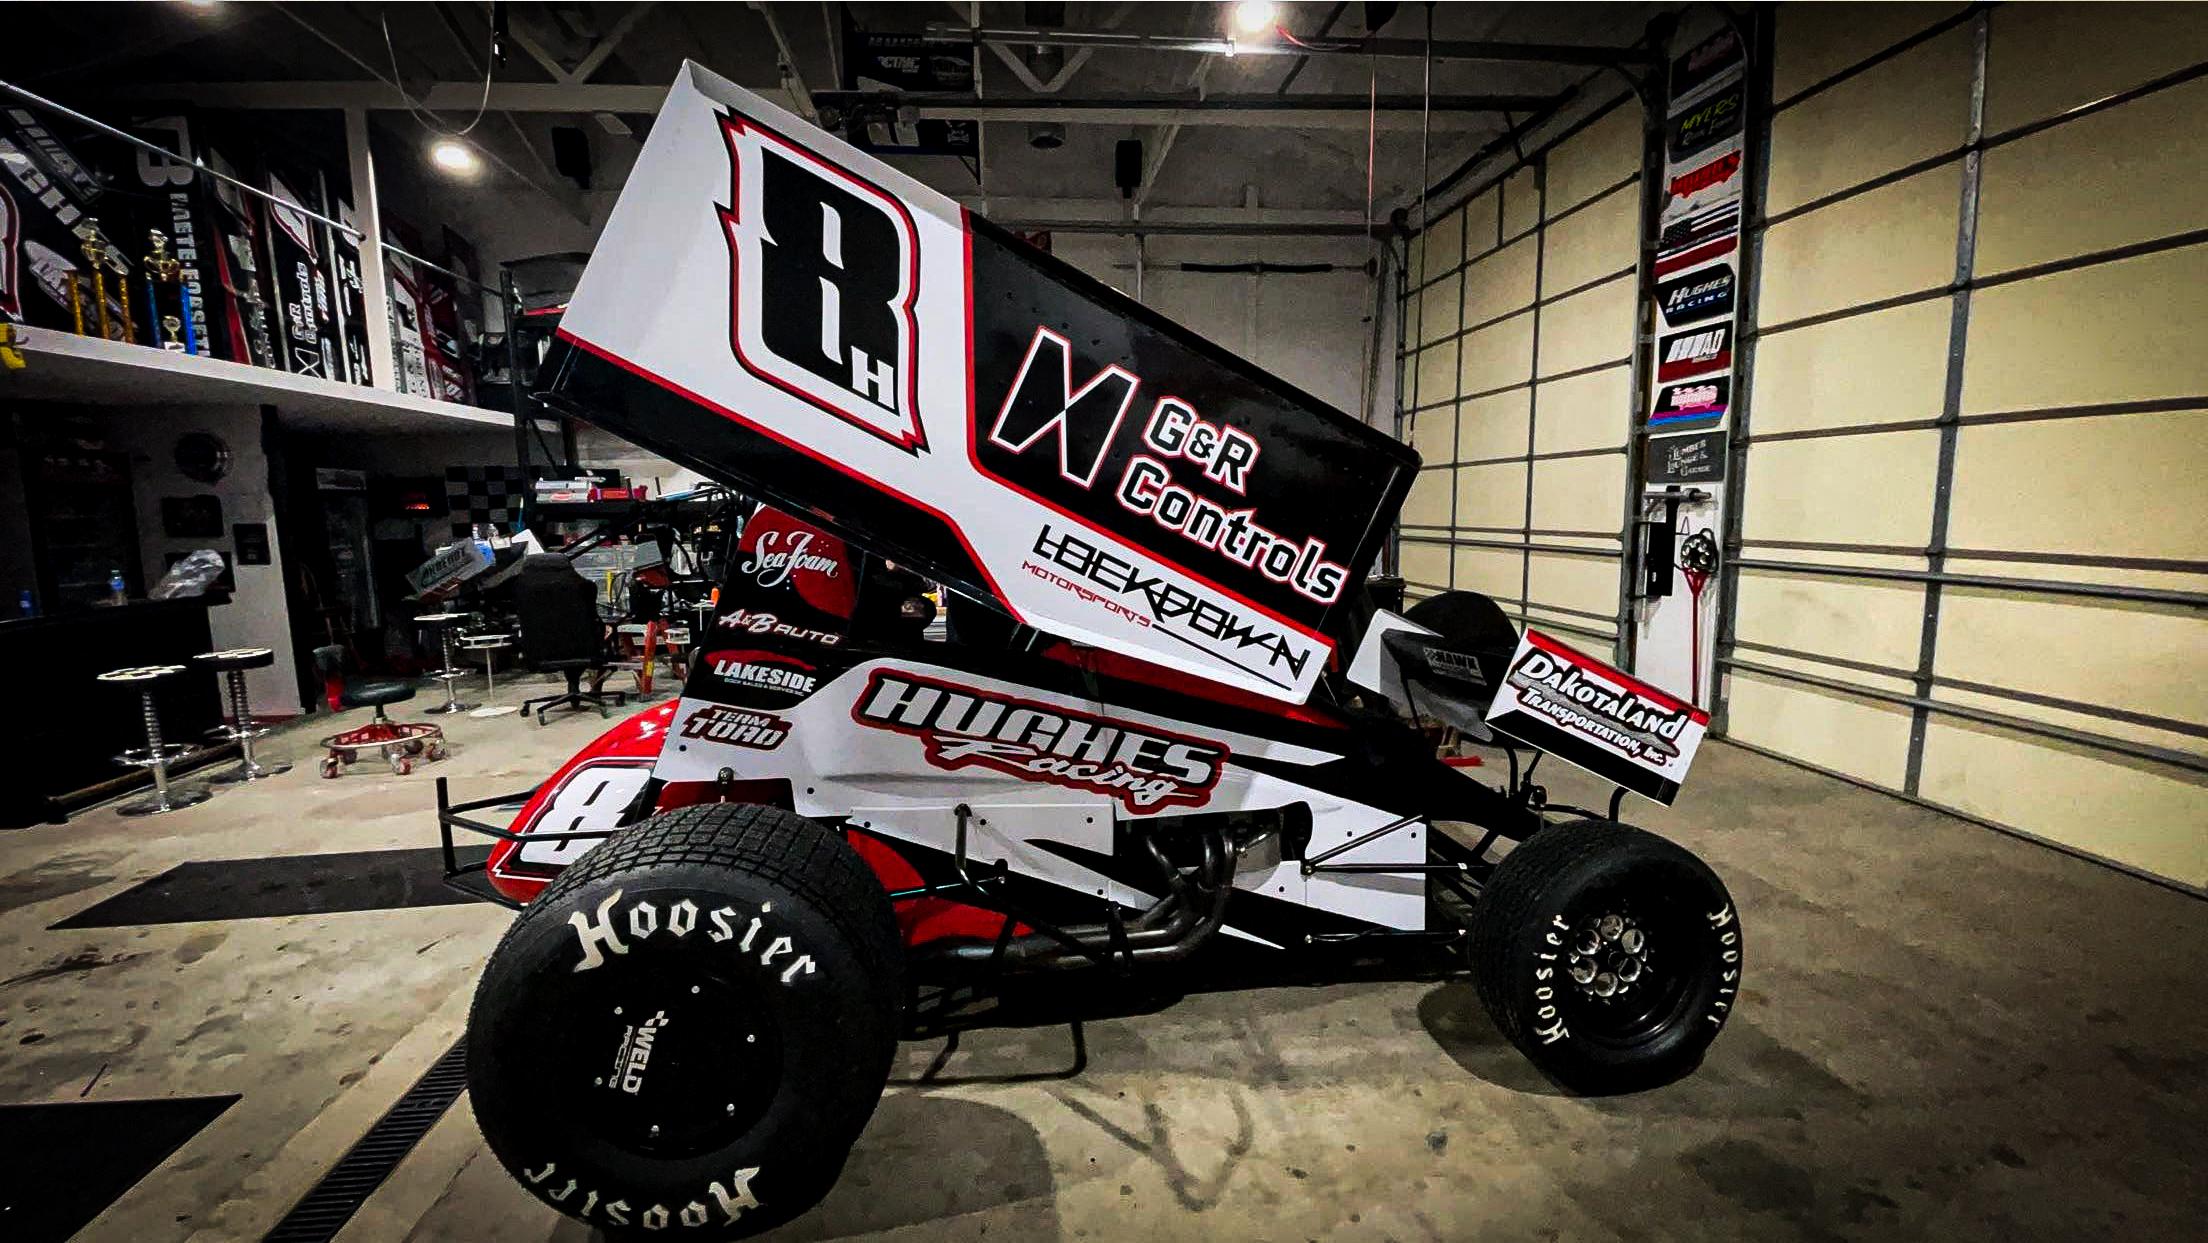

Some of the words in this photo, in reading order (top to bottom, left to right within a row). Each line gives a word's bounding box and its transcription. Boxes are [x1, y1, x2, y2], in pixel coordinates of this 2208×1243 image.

[1143, 397, 1260, 495] G&R
[1117, 455, 1349, 603] Controls
[1022, 560, 1152, 628] MOTORSPORTS
[773, 624, 840, 645] AUTO
[714, 659, 817, 693] LAKESIDE
[712, 709, 771, 727] TEAM
[865, 678, 1221, 785] HUGHES
[933, 735, 1199, 806] Racing
[567, 888, 817, 984] Hoosier
[1534, 914, 1570, 1045] Hoosier
[622, 1027, 657, 1093] WELD
